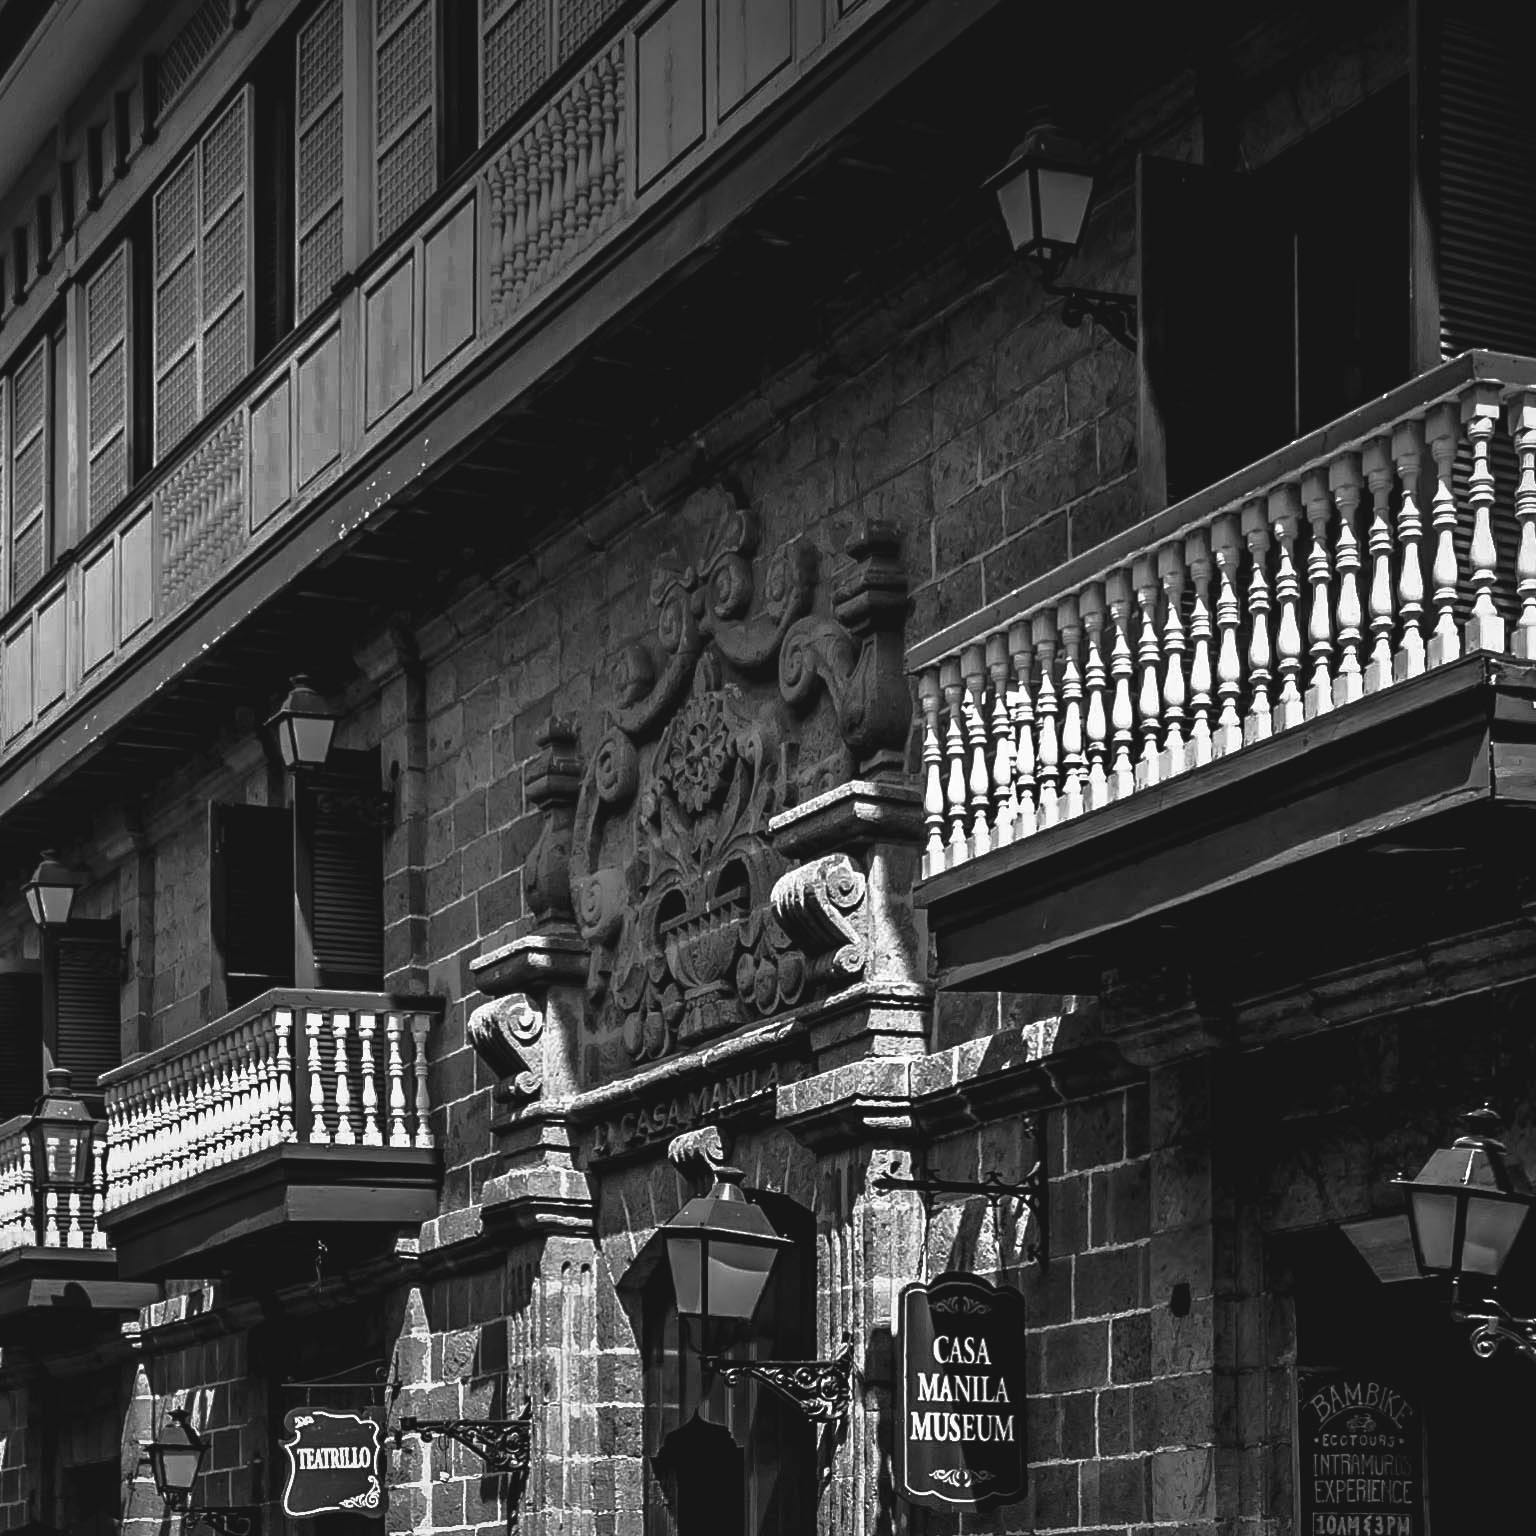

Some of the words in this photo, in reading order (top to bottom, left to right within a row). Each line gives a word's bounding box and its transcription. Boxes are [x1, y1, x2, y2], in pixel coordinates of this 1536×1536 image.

[933, 1335, 992, 1365] CASA
[917, 1372, 1010, 1403] MANILA
[1310, 1381, 1414, 1430] BAMBIKE
[910, 1411, 1015, 1442] MUSEUM
[297, 1447, 371, 1470] TEATRILLO
[1314, 1478, 1413, 1504] EXPERIENCE
[1316, 1515, 1360, 1536] 10AM
